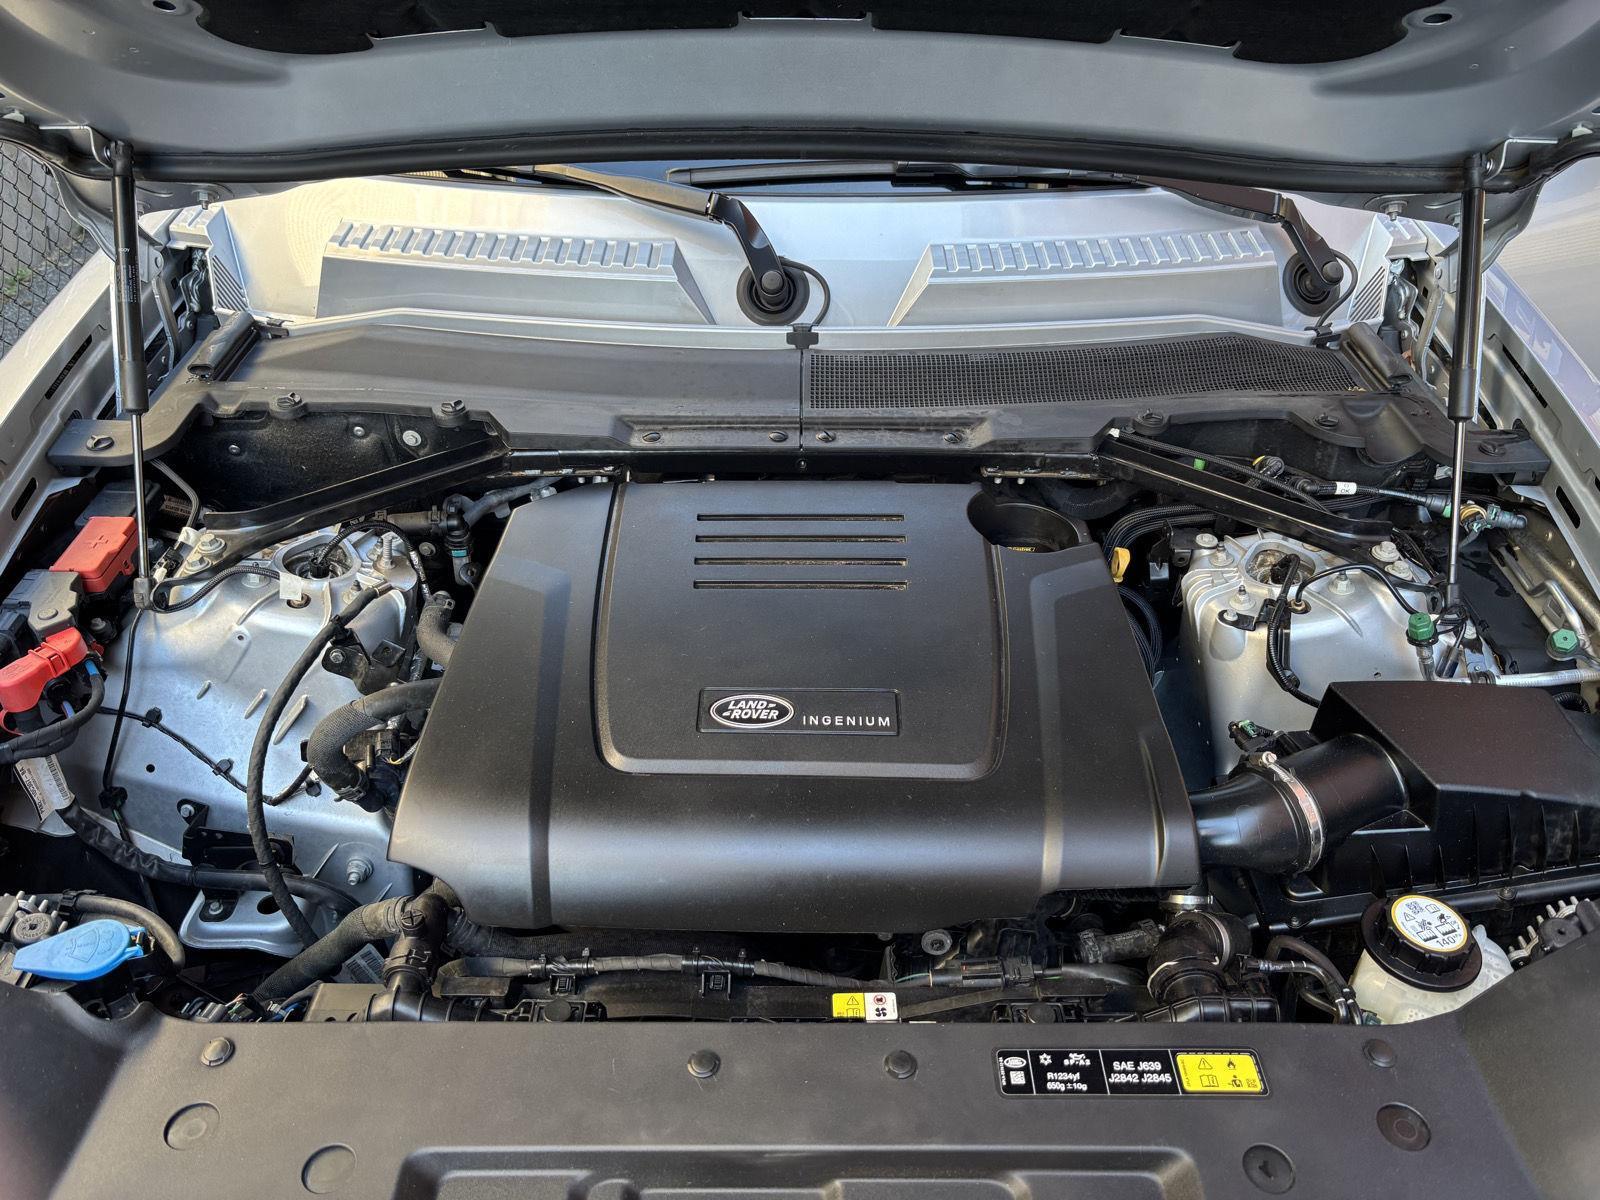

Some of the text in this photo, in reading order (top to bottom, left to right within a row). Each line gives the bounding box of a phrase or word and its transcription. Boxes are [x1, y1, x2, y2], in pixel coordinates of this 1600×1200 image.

[728, 701, 767, 709] LAND
[730, 709, 779, 720] ROVER
[802, 715, 890, 727] INGENIUM
[1436, 936, 1456, 947] 140
[1113, 1061, 1161, 1071] SAE J639
[1046, 1072, 1080, 1081] R1234yf
[1108, 1073, 1172, 1083] J2842 J2845
[1046, 1082, 1065, 1091] 650g
